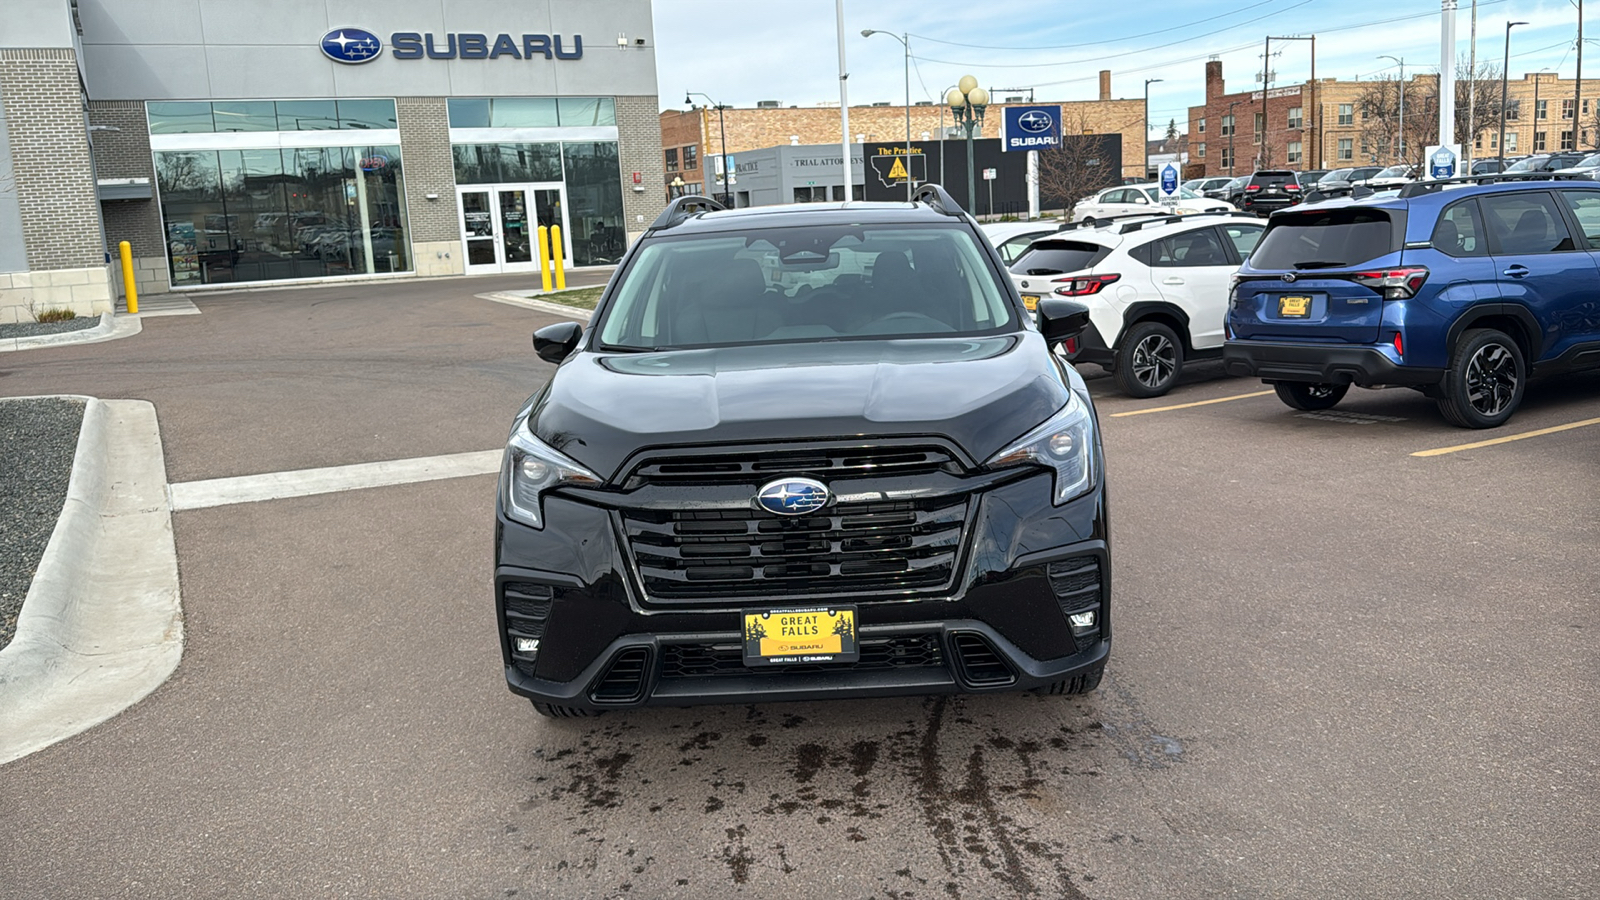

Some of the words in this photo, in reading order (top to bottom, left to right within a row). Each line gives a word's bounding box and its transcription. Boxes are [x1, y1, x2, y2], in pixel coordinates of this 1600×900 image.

[391, 32, 583, 60] SUBARU
[1011, 136, 1059, 147] SUBARU
[894, 146, 922, 155] Pratice
[795, 158, 819, 167] TRIAL
[820, 157, 864, 166] ATTOREYS
[781, 616, 817, 625] GREAT
[781, 626, 818, 636] FALLS
